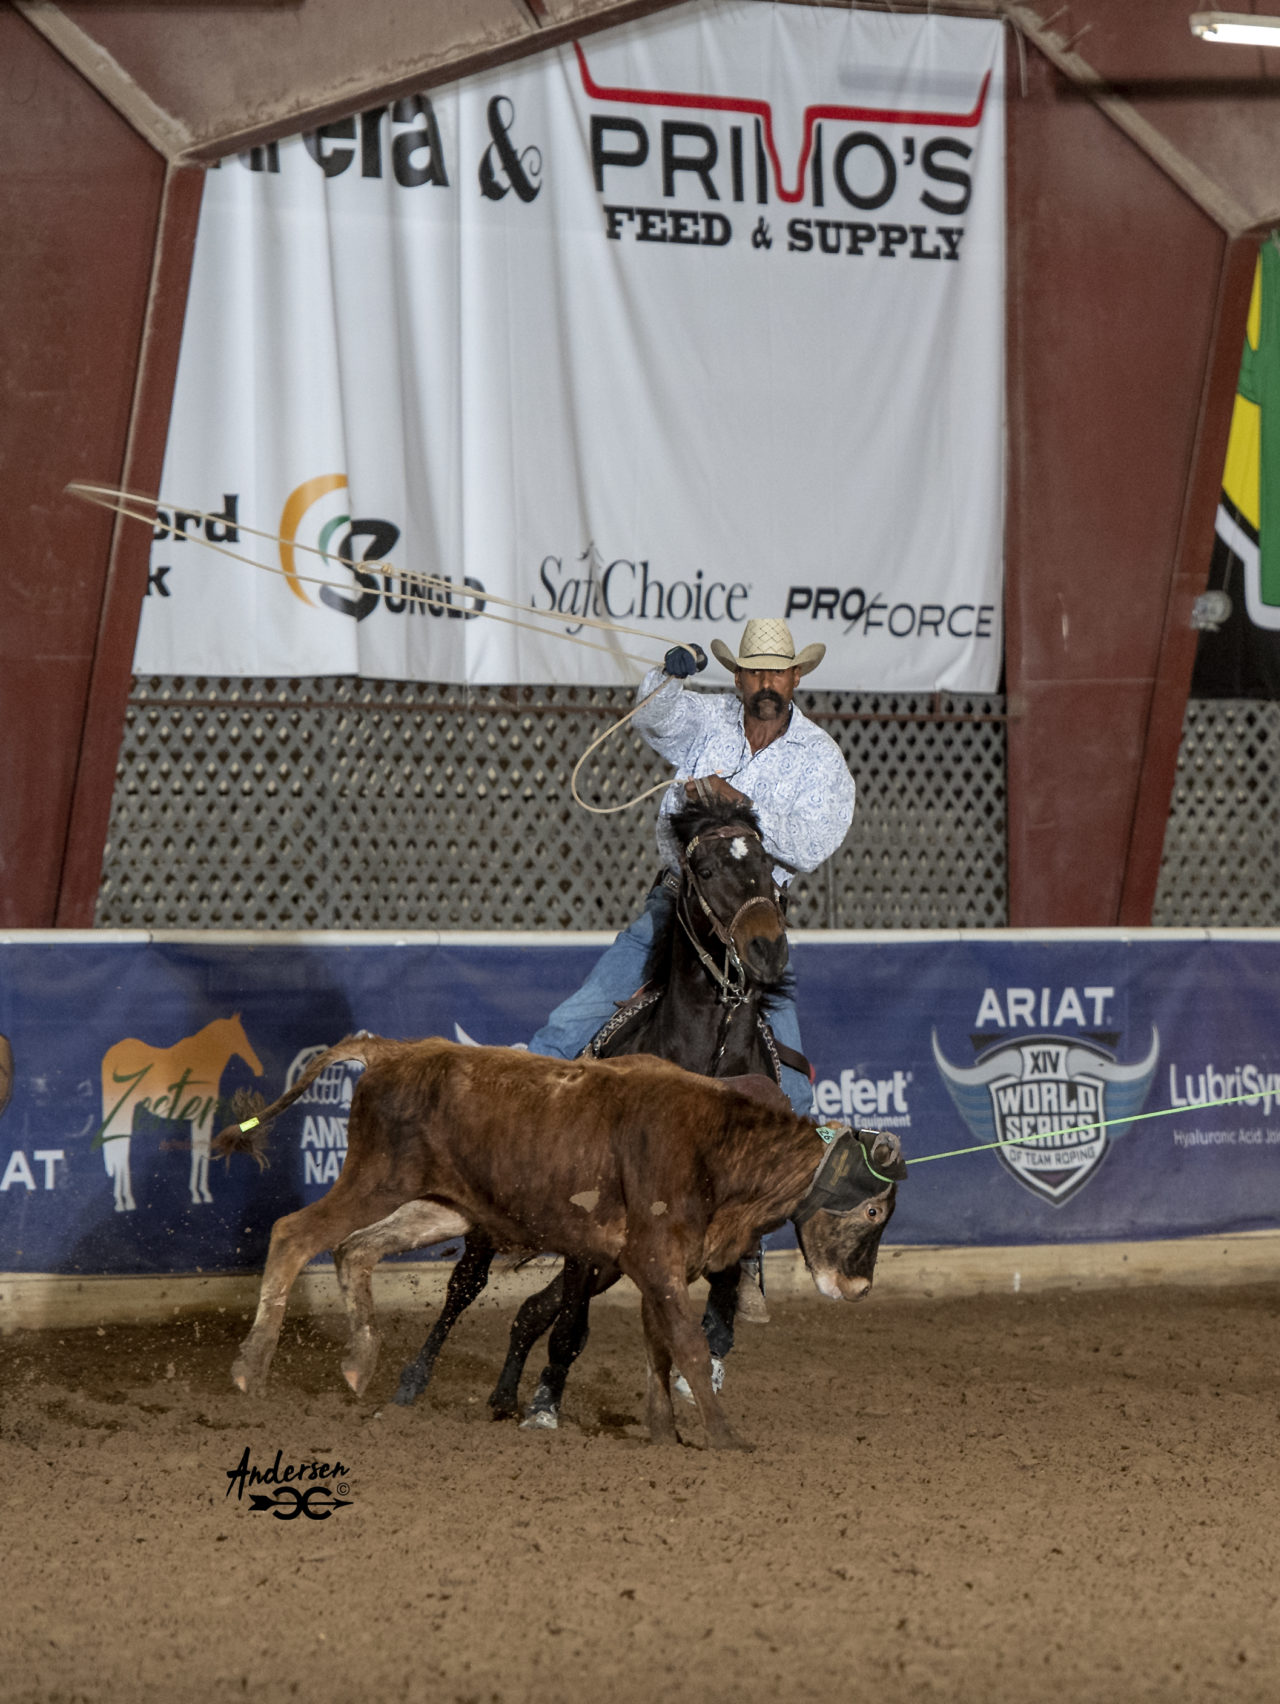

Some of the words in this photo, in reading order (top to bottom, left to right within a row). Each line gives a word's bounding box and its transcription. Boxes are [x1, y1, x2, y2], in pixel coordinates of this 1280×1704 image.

[478, 95, 542, 203] &
[590, 114, 974, 216] PRIMO'S
[603, 205, 732, 247] FEED
[752, 216, 772, 251] &
[787, 218, 964, 261] SUPPLY
[975, 987, 1114, 1028] ARIAT
[1030, 1051, 1060, 1074] XIV
[998, 1082, 1097, 1115] WORLD
[854, 1114, 911, 1130] Equipment
[1004, 1114, 1097, 1148] SERIES
[1173, 1128, 1235, 1148] Hyaluronic
[1239, 1128, 1262, 1145] Acid
[1009, 1149, 1023, 1162] OF
[1026, 1151, 1051, 1166] TEAM
[1055, 1146, 1096, 1164] ROPING
